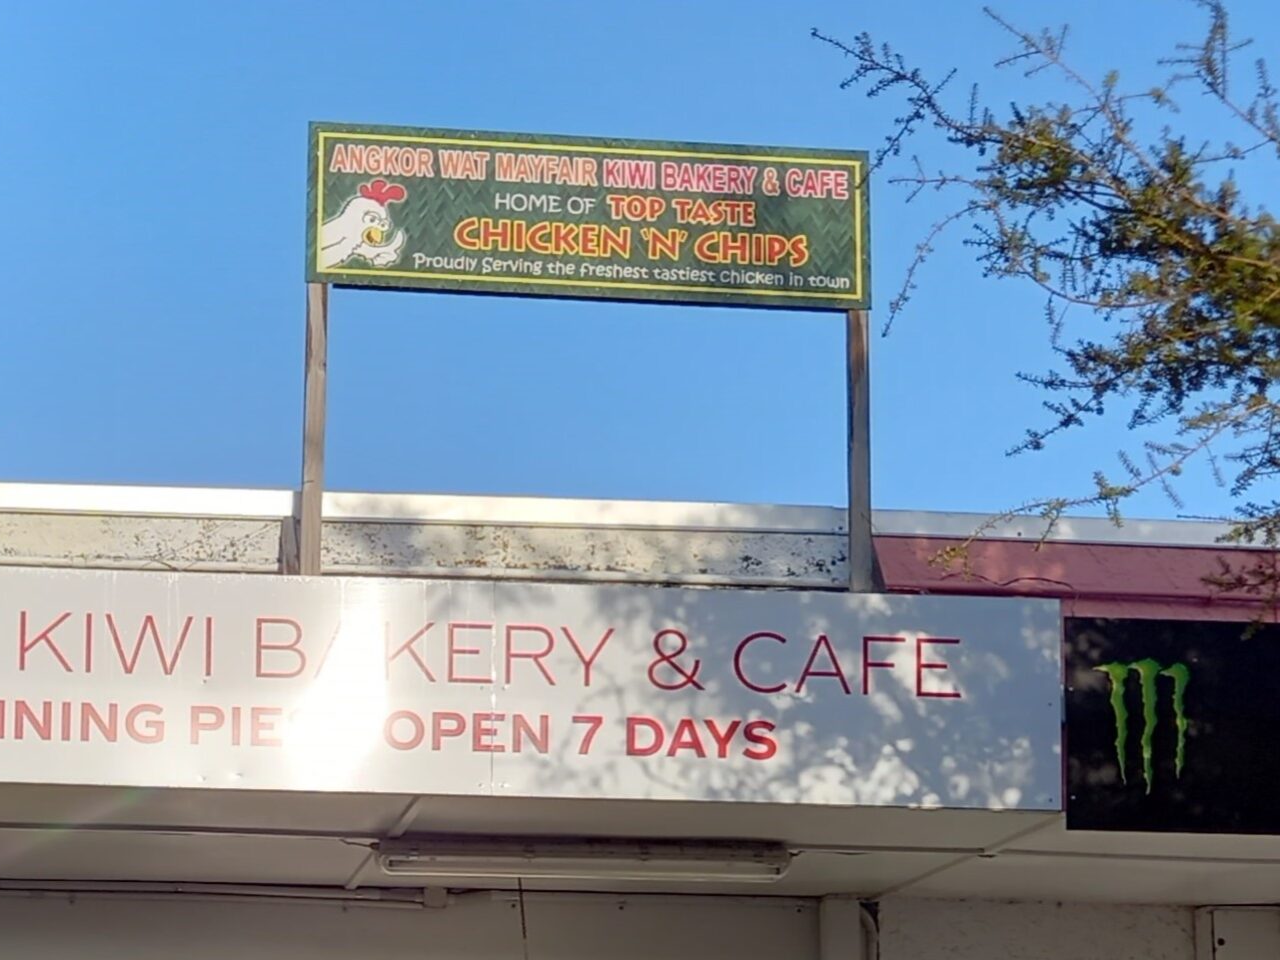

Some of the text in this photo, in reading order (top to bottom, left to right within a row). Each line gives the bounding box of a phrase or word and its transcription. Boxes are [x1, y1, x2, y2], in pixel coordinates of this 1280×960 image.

[330, 144, 849, 199] ANGKOR WAT MAYFAIR KIWI BAKERY & CAFE
[494, 192, 595, 214] HOME OF
[607, 195, 756, 226] TOP TASTE
[454, 217, 631, 260] CHICKEN
[694, 231, 809, 267] CHIPS
[412, 252, 477, 272] Proudly
[547, 259, 575, 276] the
[580, 261, 649, 279] freshest
[653, 265, 716, 282] tastiest
[789, 272, 804, 287] in
[808, 275, 850, 289] town
[18, 610, 213, 679] KIWI
[646, 627, 702, 692] &
[732, 629, 962, 700] CAFE
[188, 702, 300, 748] PIE
[384, 709, 549, 756] OPEN
[570, 714, 604, 756] 7
[624, 716, 778, 761] DAYS
